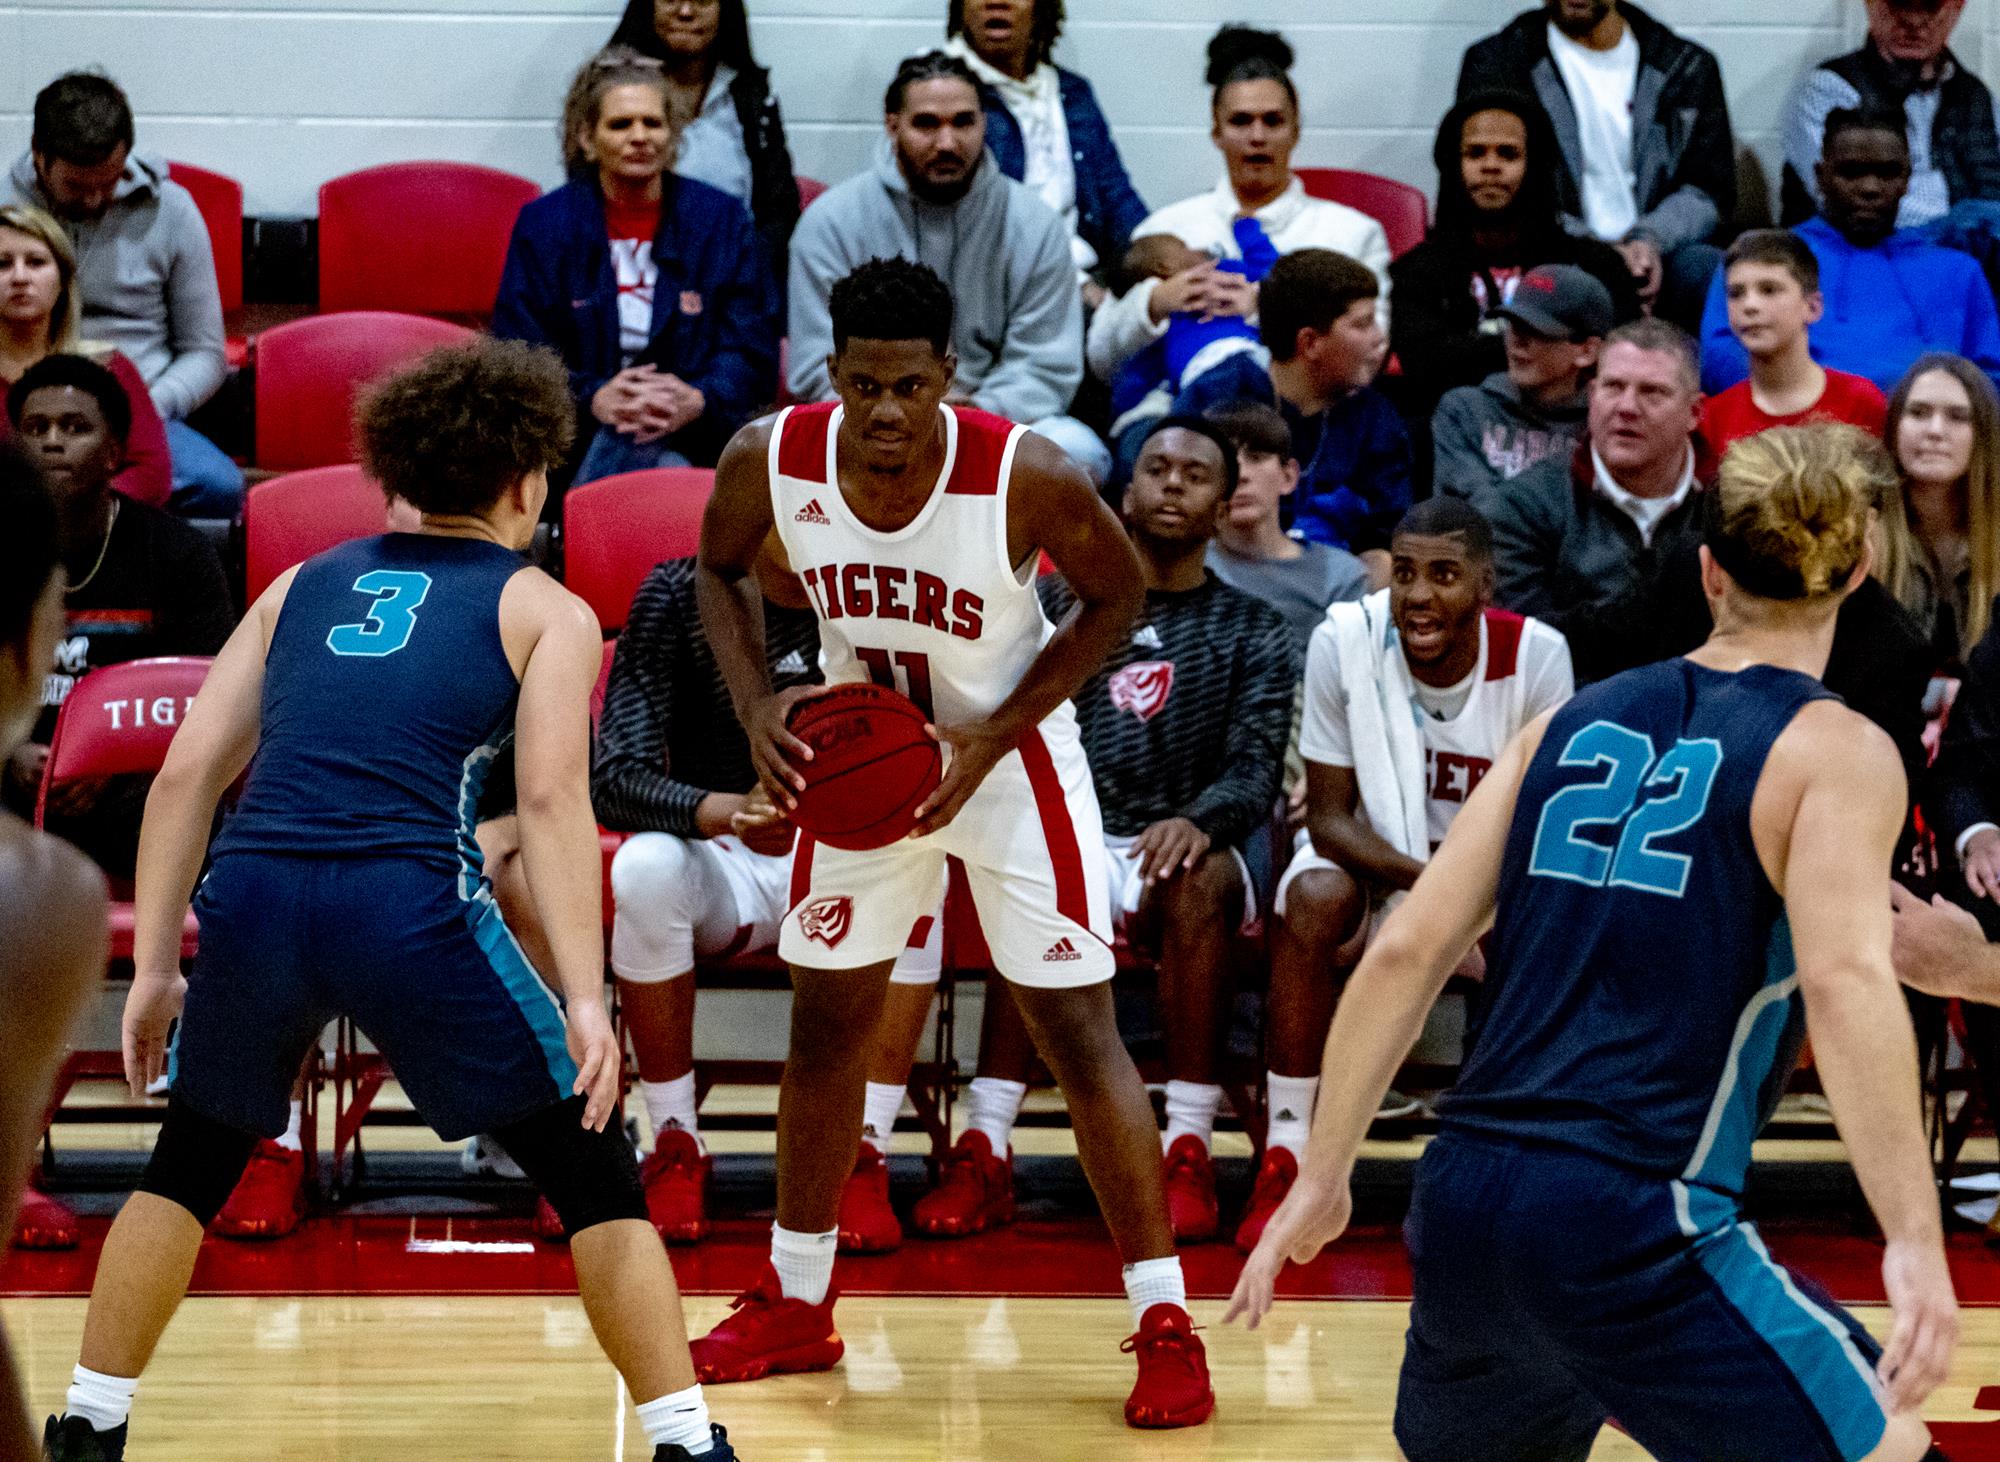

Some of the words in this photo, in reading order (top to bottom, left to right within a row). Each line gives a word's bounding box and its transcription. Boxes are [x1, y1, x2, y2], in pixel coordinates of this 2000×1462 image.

[794, 512, 831, 526] adidas
[326, 569, 433, 657] 3
[103, 696, 194, 730] TIG
[1527, 719, 1724, 898] 22
[1043, 951, 1082, 961] adidas
